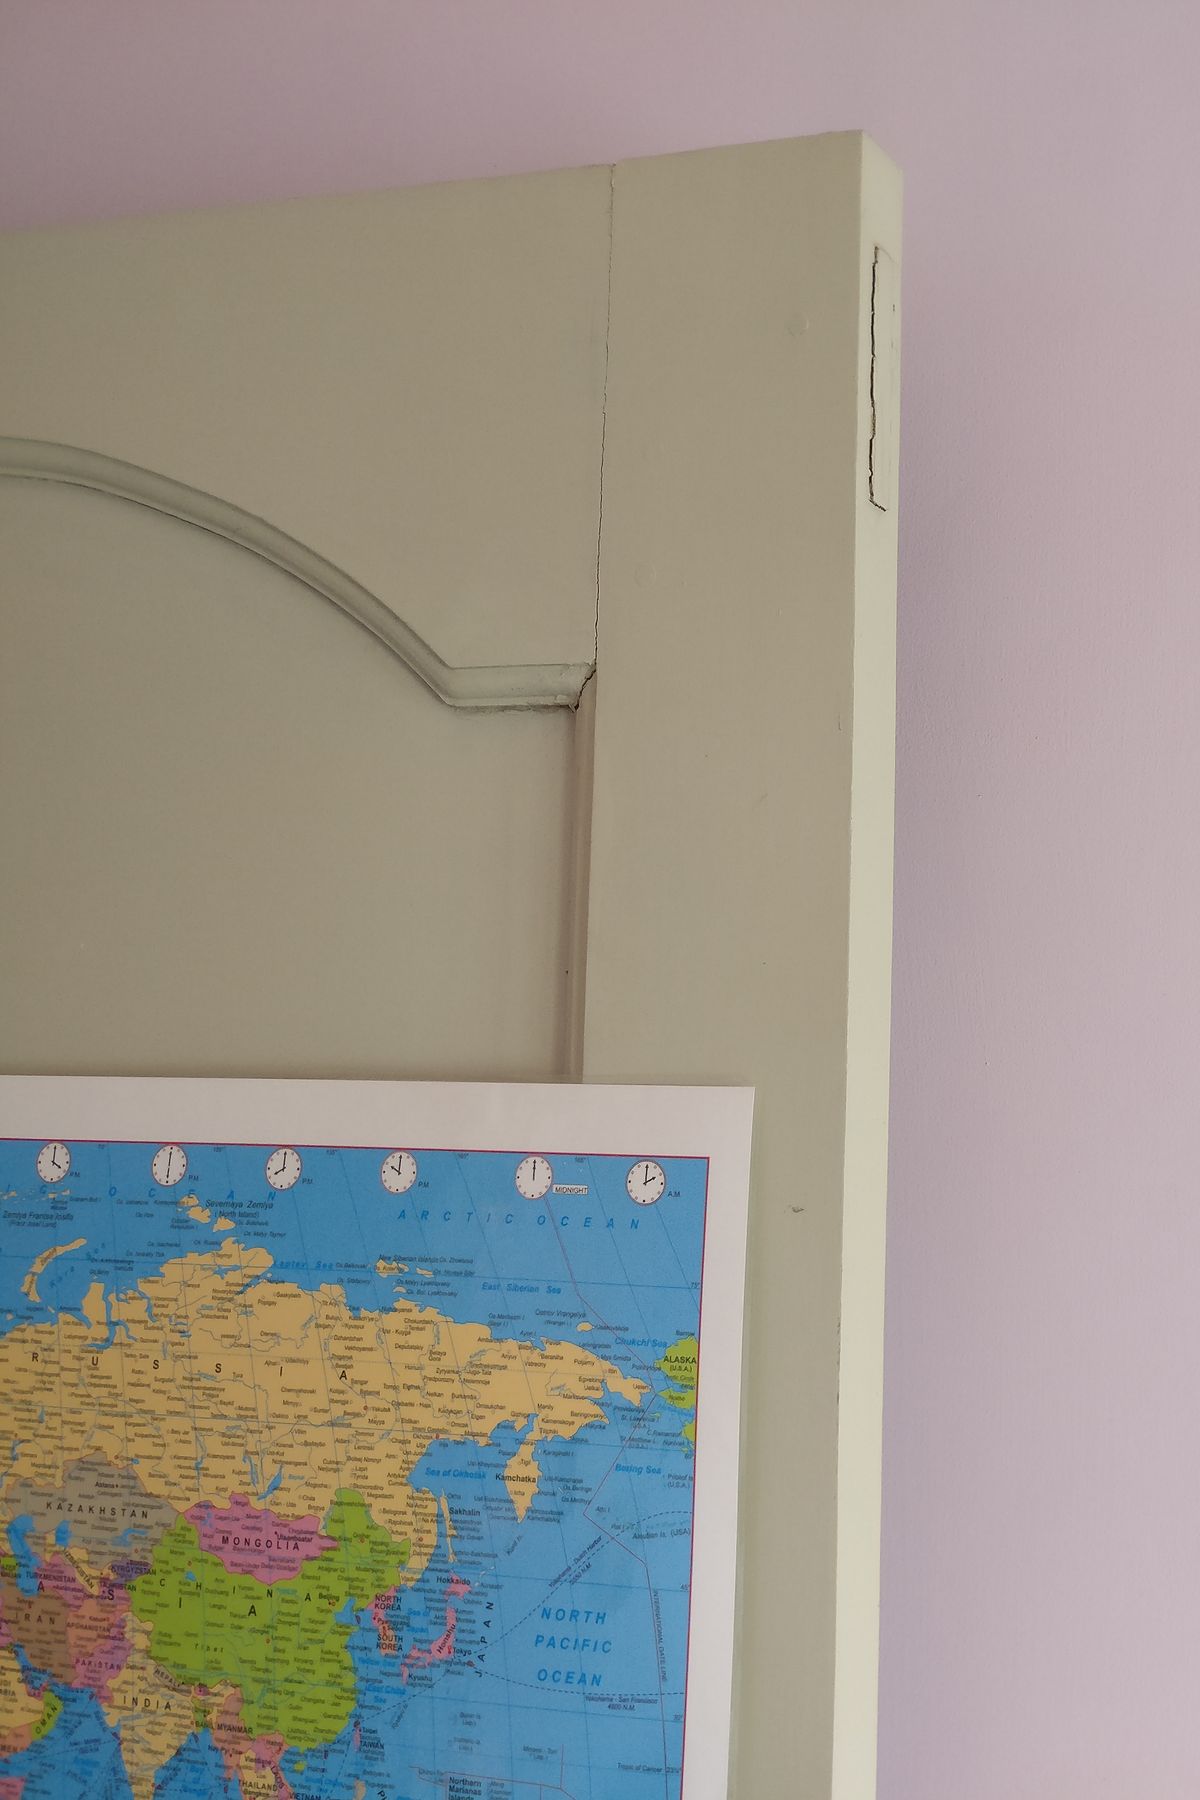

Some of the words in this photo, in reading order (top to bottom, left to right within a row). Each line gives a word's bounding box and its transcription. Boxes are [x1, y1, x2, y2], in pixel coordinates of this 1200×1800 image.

[554, 1186, 588, 1194] MIDNIGHT
[398, 1209, 514, 1224] ARCTIC
[537, 1214, 640, 1230] OCEAN
[663, 1355, 697, 1364] ALASKA
[495, 1473, 537, 1484] Kamchatka
[46, 1501, 149, 1519] KAZAKHSTAN
[449, 1507, 481, 1517] Sakhalin
[221, 1536, 300, 1551] MONGOLIA
[436, 1576, 471, 1586] Hokkaido
[375, 1594, 402, 1603] NORTH
[374, 1602, 401, 1611] KOREA
[541, 1606, 607, 1625] NORTH
[377, 1634, 403, 1643] SOUTH
[534, 1634, 613, 1654] PACIFIC
[376, 1642, 403, 1651] KOREA
[536, 1668, 603, 1687] OCEAN
[123, 1695, 172, 1711] INDIA
[217, 1723, 254, 1735] MYANMAR
[448, 1776, 482, 1788] Northern
